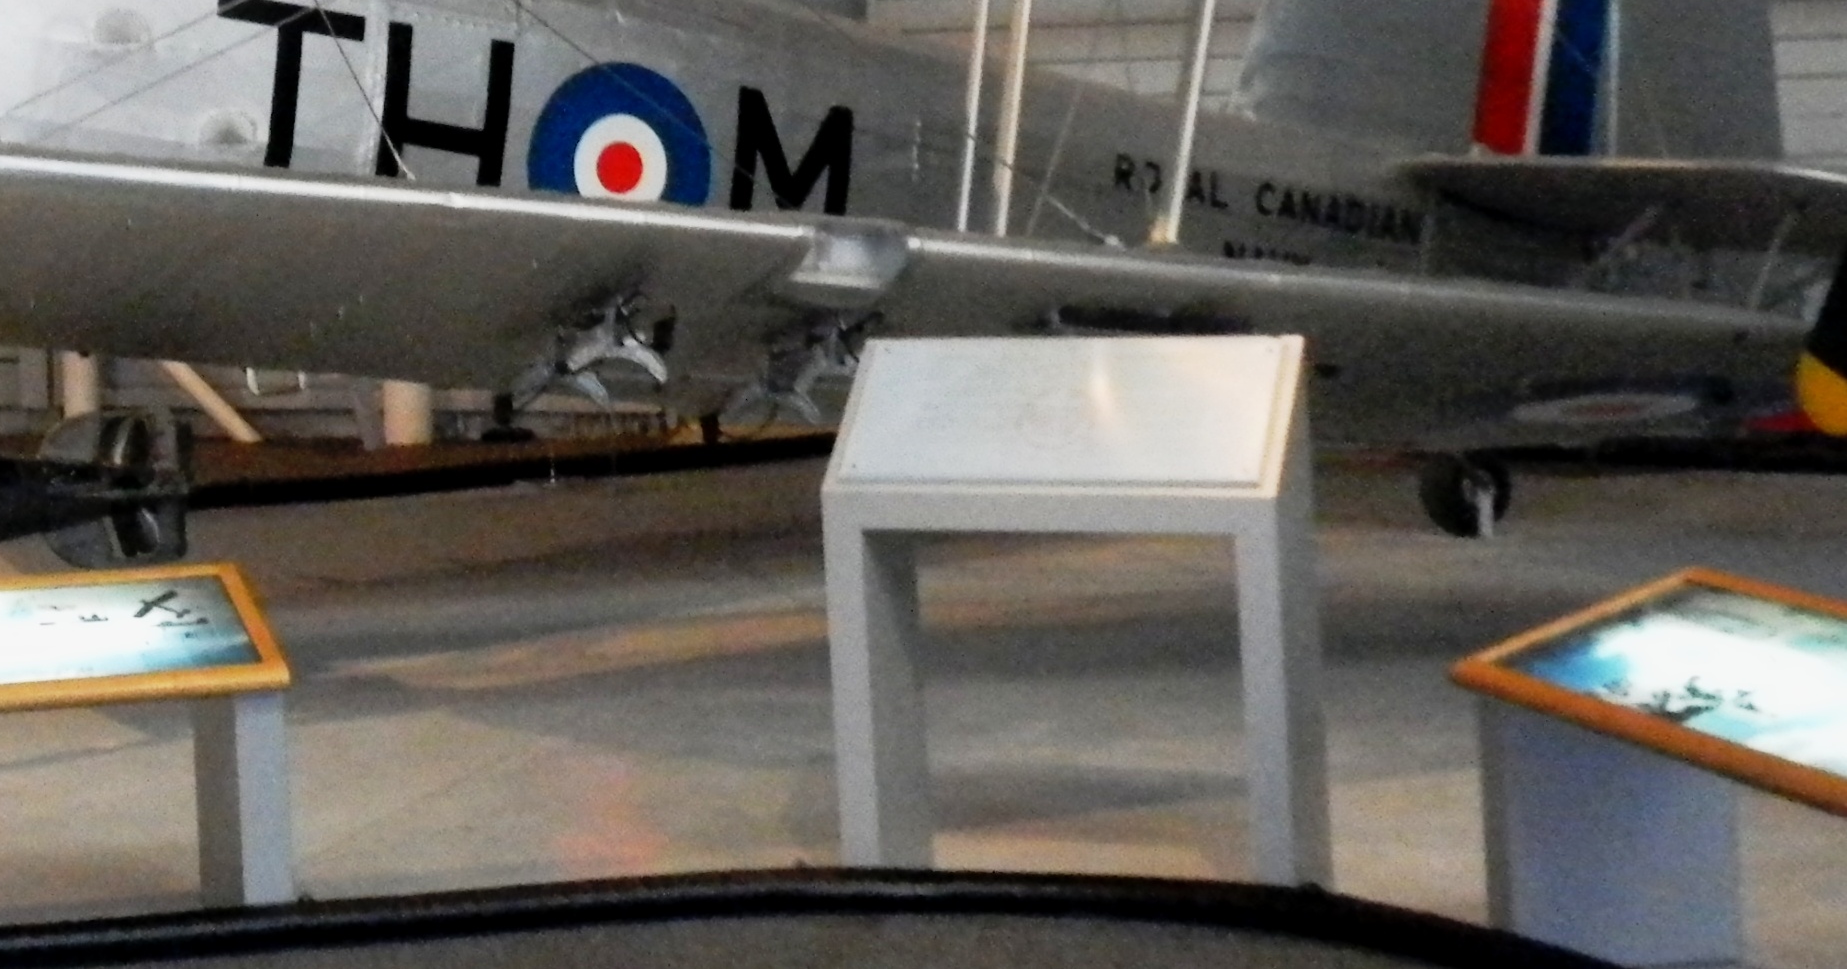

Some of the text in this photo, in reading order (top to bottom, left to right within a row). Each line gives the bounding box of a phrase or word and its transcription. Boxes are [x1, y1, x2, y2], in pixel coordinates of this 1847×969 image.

[729, 85, 854, 216] M
[1114, 153, 1423, 244] ROAL CANADIAN
